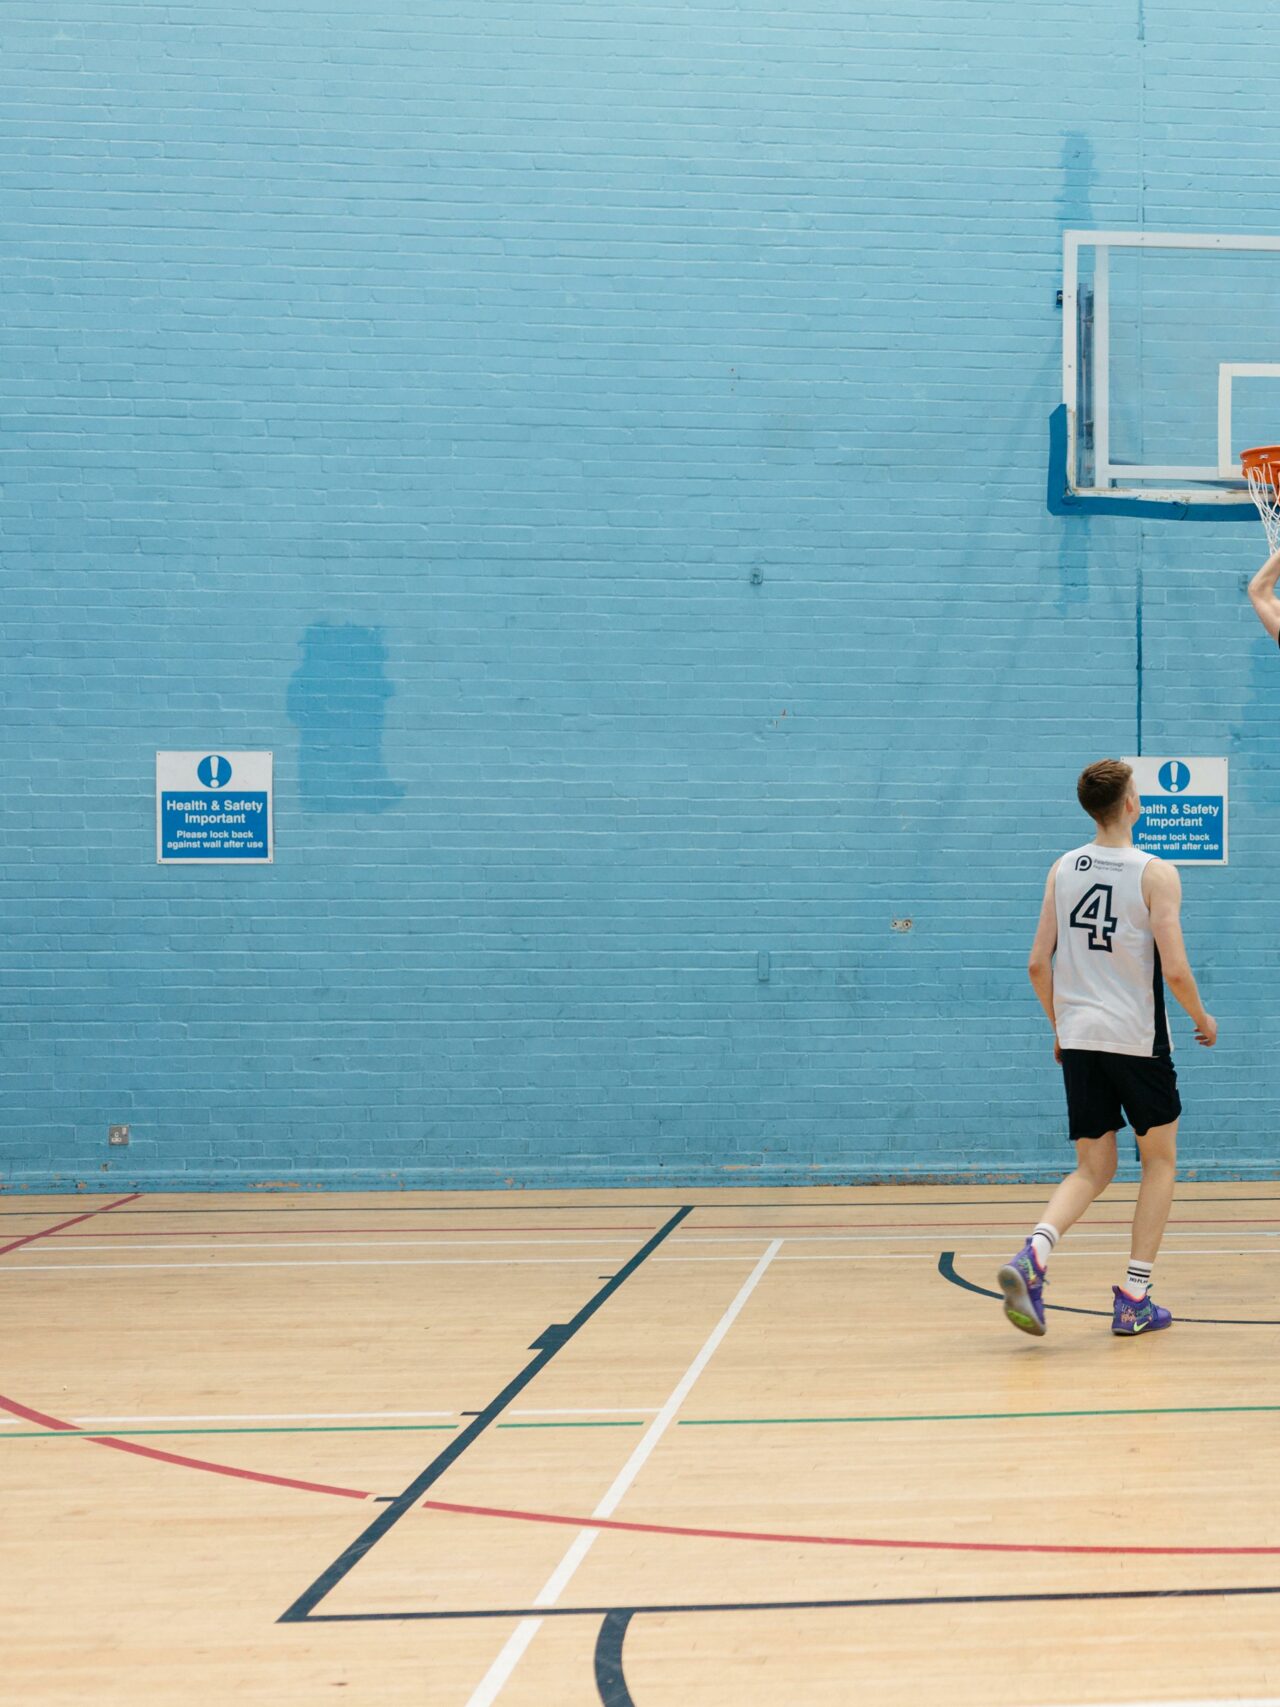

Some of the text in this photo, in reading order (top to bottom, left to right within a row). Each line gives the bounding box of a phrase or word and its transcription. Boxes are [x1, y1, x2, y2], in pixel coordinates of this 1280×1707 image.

[167, 800, 263, 813] Health & Safety
[1140, 803, 1219, 816] ealth & Safety
[185, 813, 245, 826] Important
[1146, 817, 1202, 828] Important
[177, 830, 253, 838] Please lock back
[167, 841, 200, 849] against
[1133, 842, 1160, 851] gainst
[1070, 883, 1117, 953] 4
